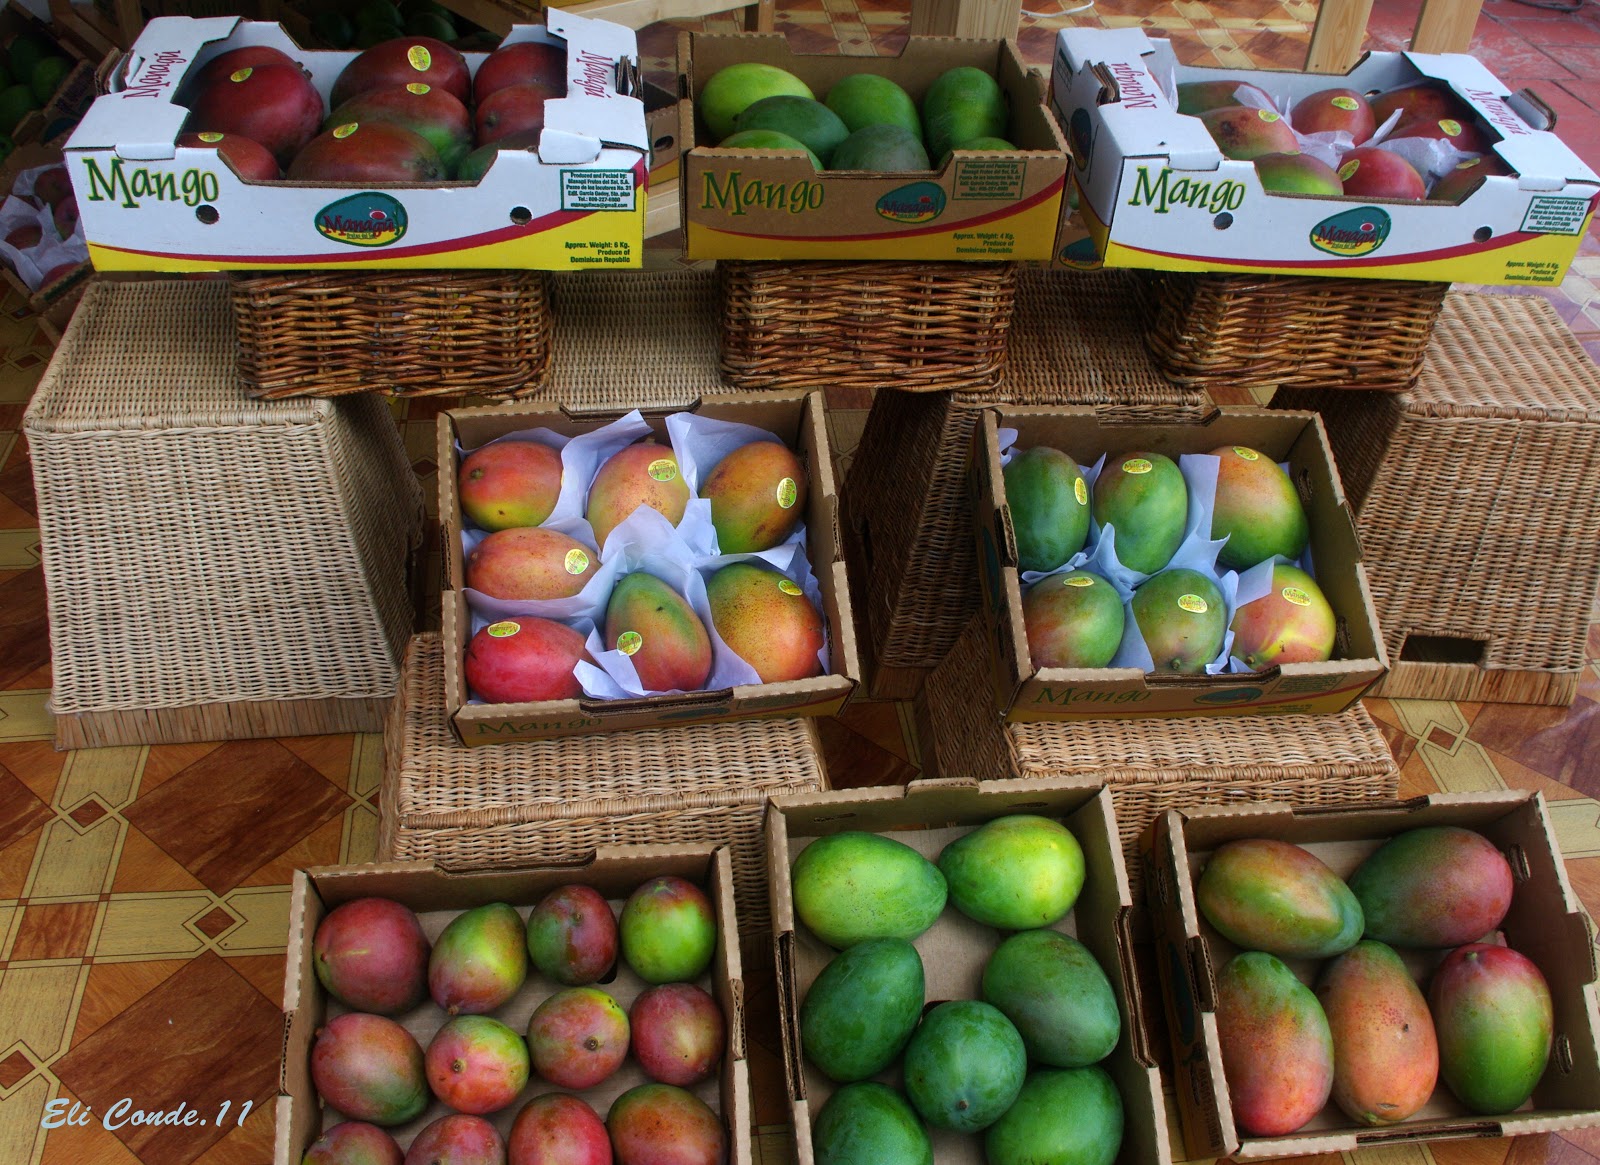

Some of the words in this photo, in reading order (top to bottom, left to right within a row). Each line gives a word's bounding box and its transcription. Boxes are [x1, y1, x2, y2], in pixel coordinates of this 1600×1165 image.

[81, 157, 219, 208] Mango
[699, 170, 825, 215] Mango
[1127, 166, 1246, 214] Mango
[603, 256, 630, 264] Republic
[1031, 687, 1152, 706] Mango
[475, 718, 603, 735] Mango
